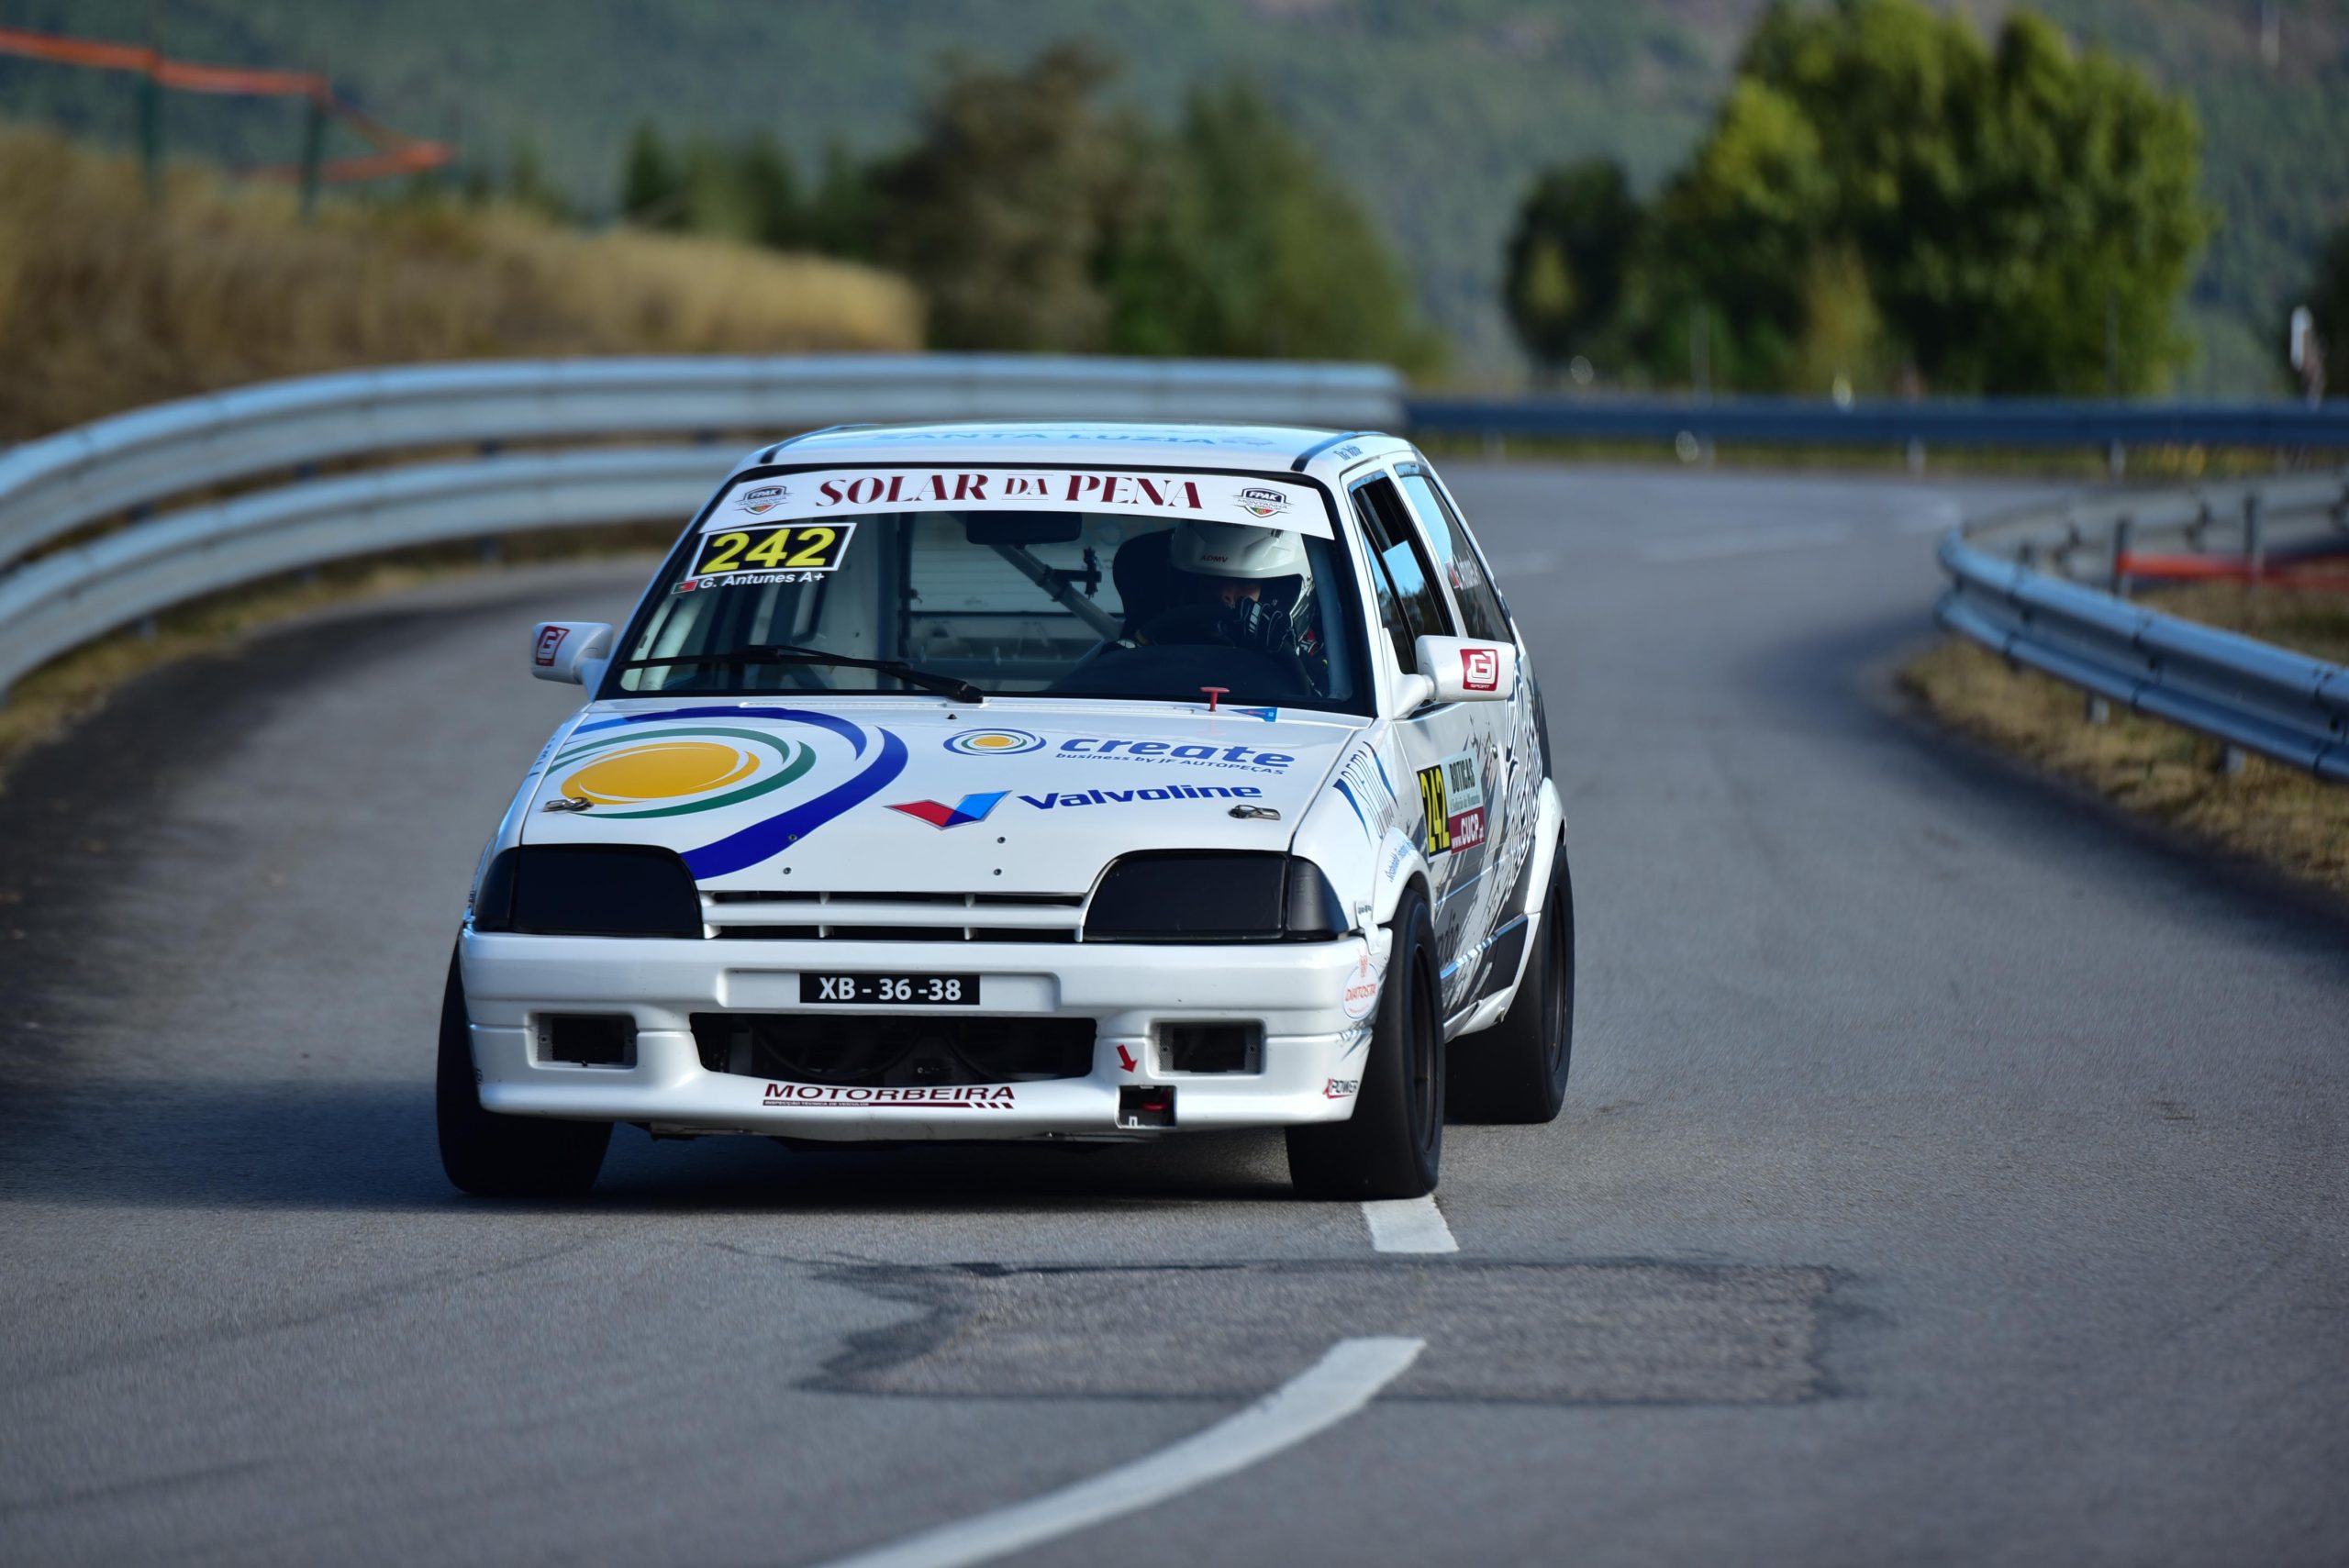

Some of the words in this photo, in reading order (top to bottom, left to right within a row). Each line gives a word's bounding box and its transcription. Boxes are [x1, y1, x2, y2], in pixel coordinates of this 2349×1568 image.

[872, 432, 1049, 440] SANTA
[1067, 433, 1217, 446] LUZIA
[816, 473, 989, 507] SOLAR
[1004, 477, 1049, 495] DA
[1064, 473, 1204, 509] PENA
[1248, 491, 1279, 501] FPAK
[700, 528, 837, 574] 242
[699, 578, 718, 590] G.
[721, 573, 796, 588] Antunes
[798, 571, 825, 583] A+
[1055, 752, 1131, 762] business
[1134, 755, 1157, 764] by
[1179, 760, 1286, 775] AUTOPEÇAS
[1059, 738, 1296, 768] create
[1016, 784, 1264, 810] Valvoline
[1419, 768, 1451, 853] 242
[763, 1083, 1016, 1100] MOTORBEIRA
